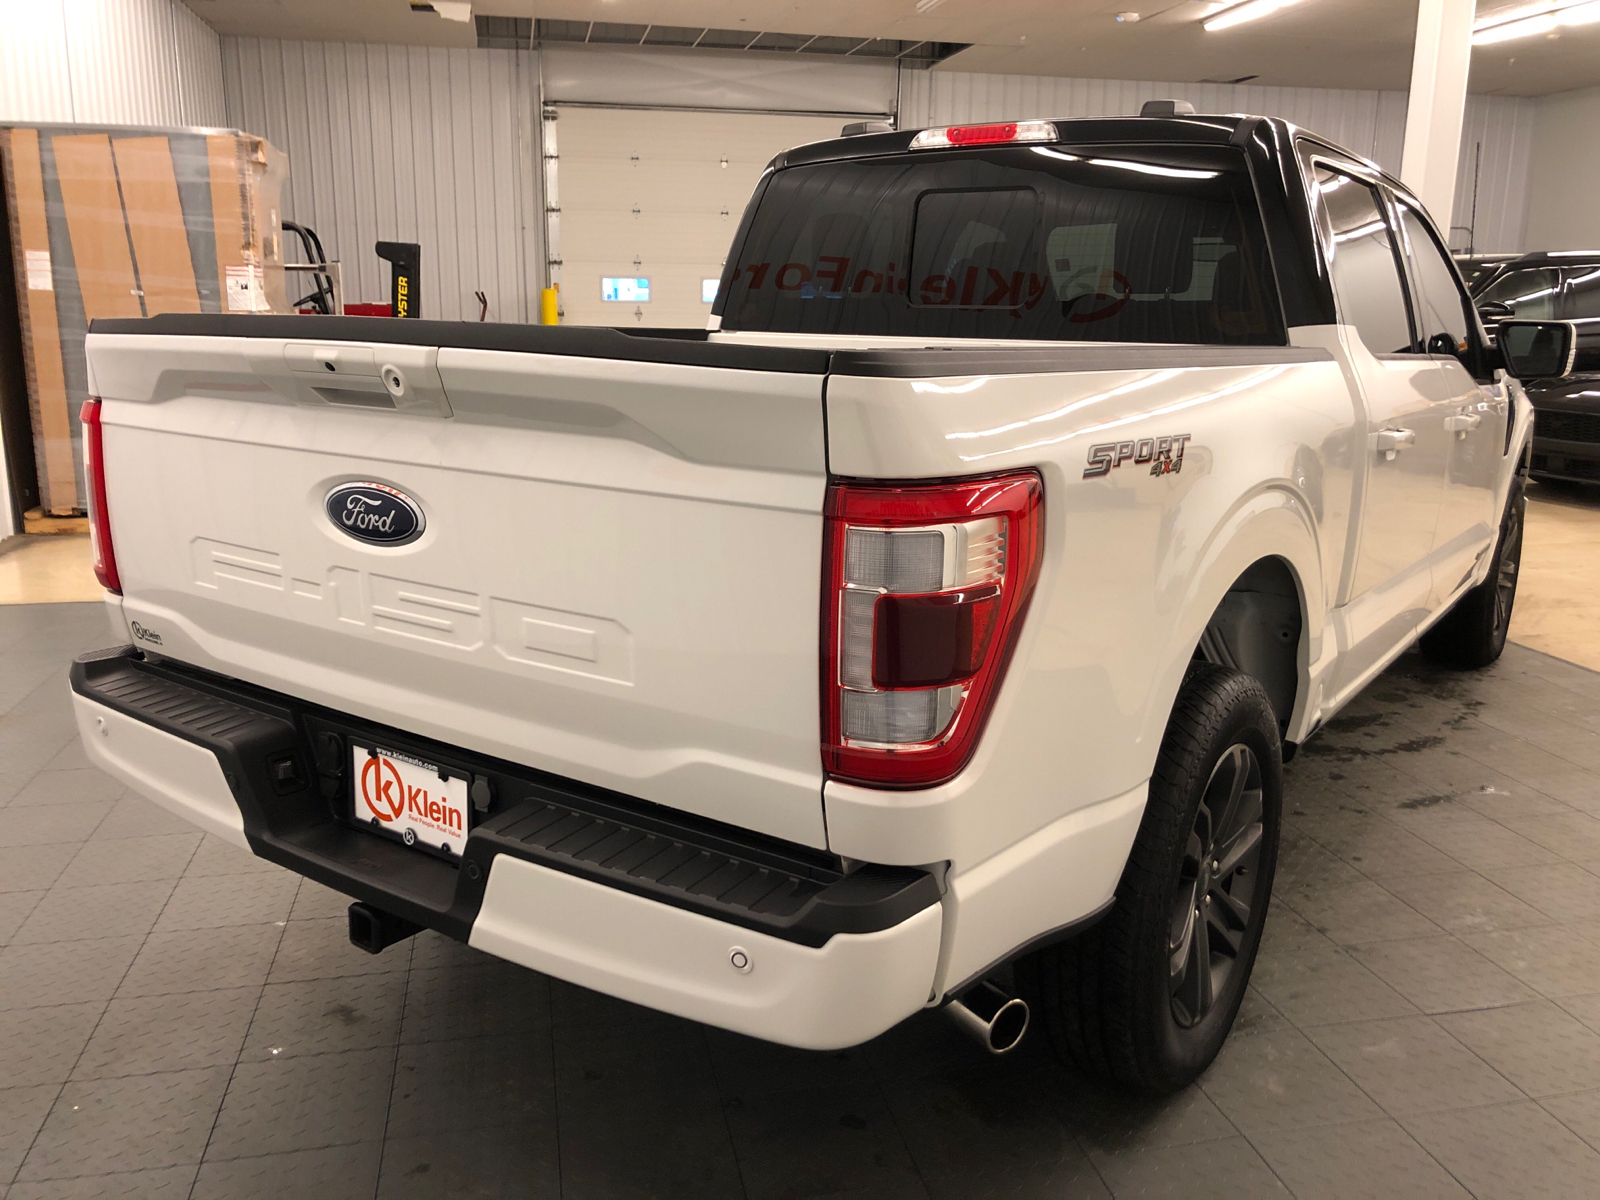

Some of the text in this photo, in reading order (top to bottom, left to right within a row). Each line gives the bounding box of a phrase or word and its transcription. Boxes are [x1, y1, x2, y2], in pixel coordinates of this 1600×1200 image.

[398, 276, 408, 318] YSTER
[1082, 433, 1191, 480] SPORT
[342, 494, 396, 533] Ford
[190, 537, 635, 686] F-150
[376, 747, 439, 772] www.kleinauto.com
[408, 784, 462, 831] Klein
